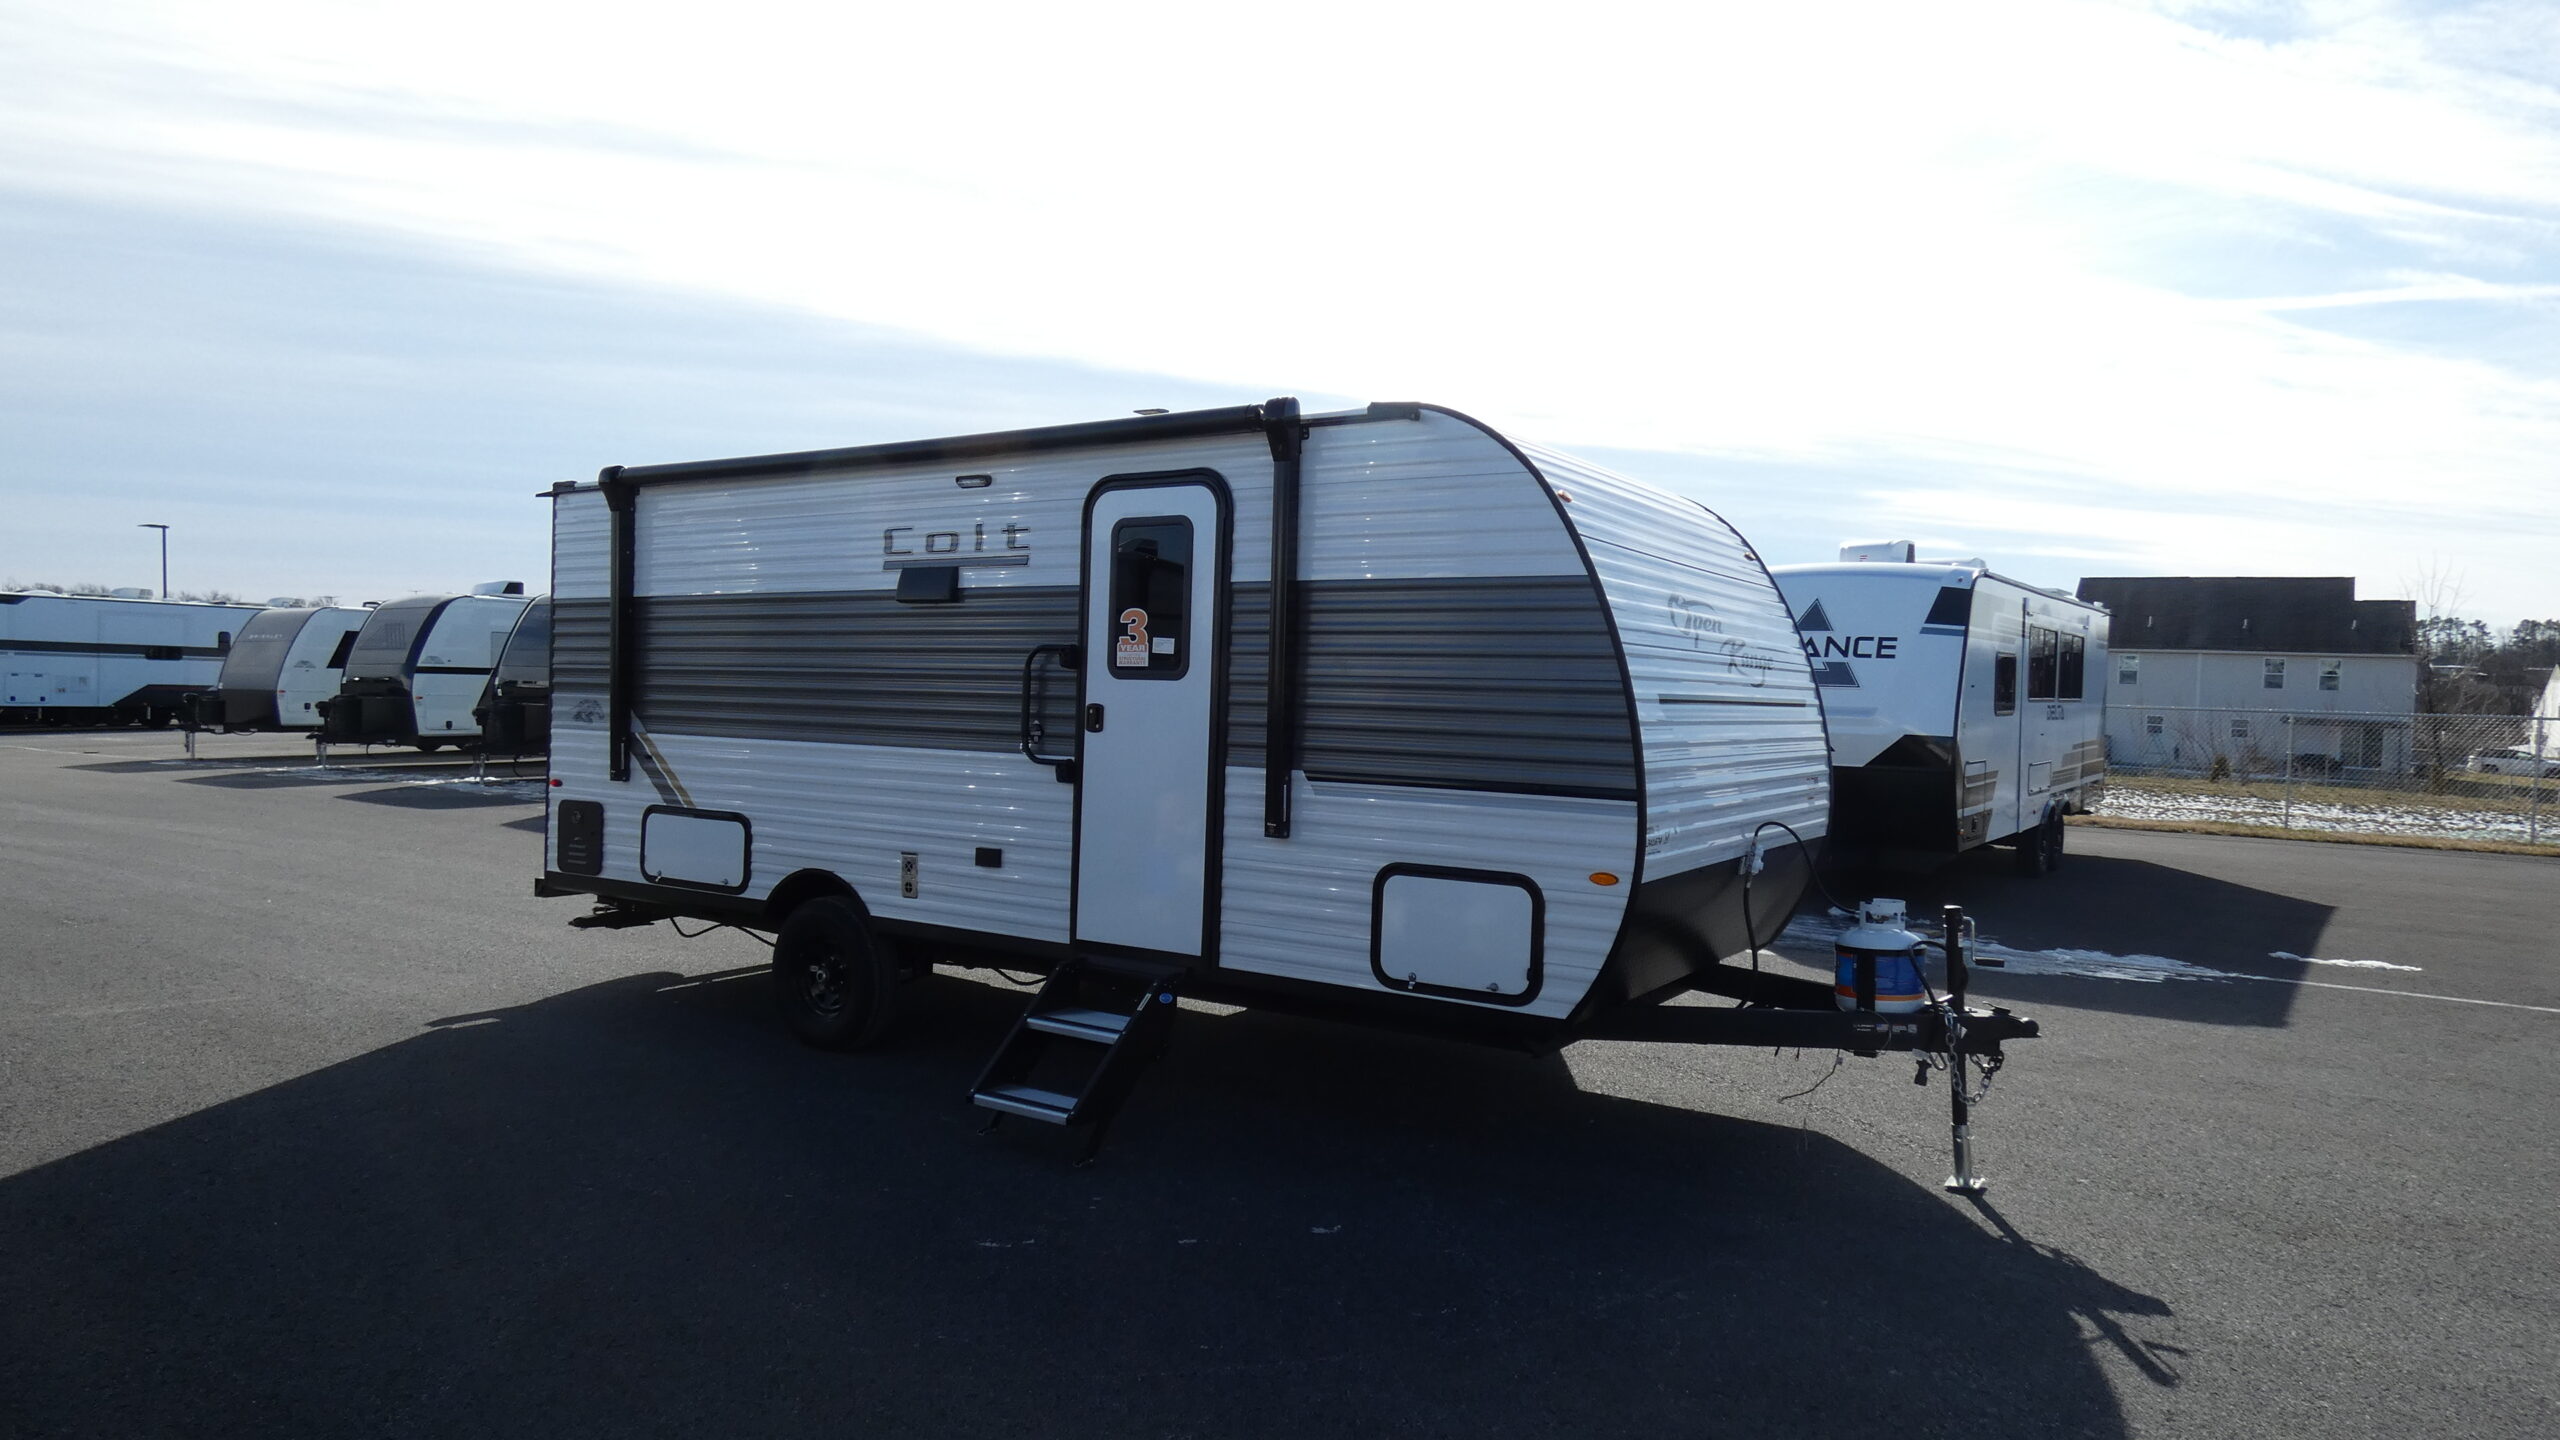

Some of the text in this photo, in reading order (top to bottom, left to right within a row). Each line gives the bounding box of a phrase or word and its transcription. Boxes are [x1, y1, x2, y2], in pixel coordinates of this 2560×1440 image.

[884, 521, 1031, 554] Colt
[1119, 608, 1148, 645] 3
[1667, 593, 1723, 649] Open
[1120, 644, 1146, 653] YEAR
[1720, 638, 1775, 688] Range
